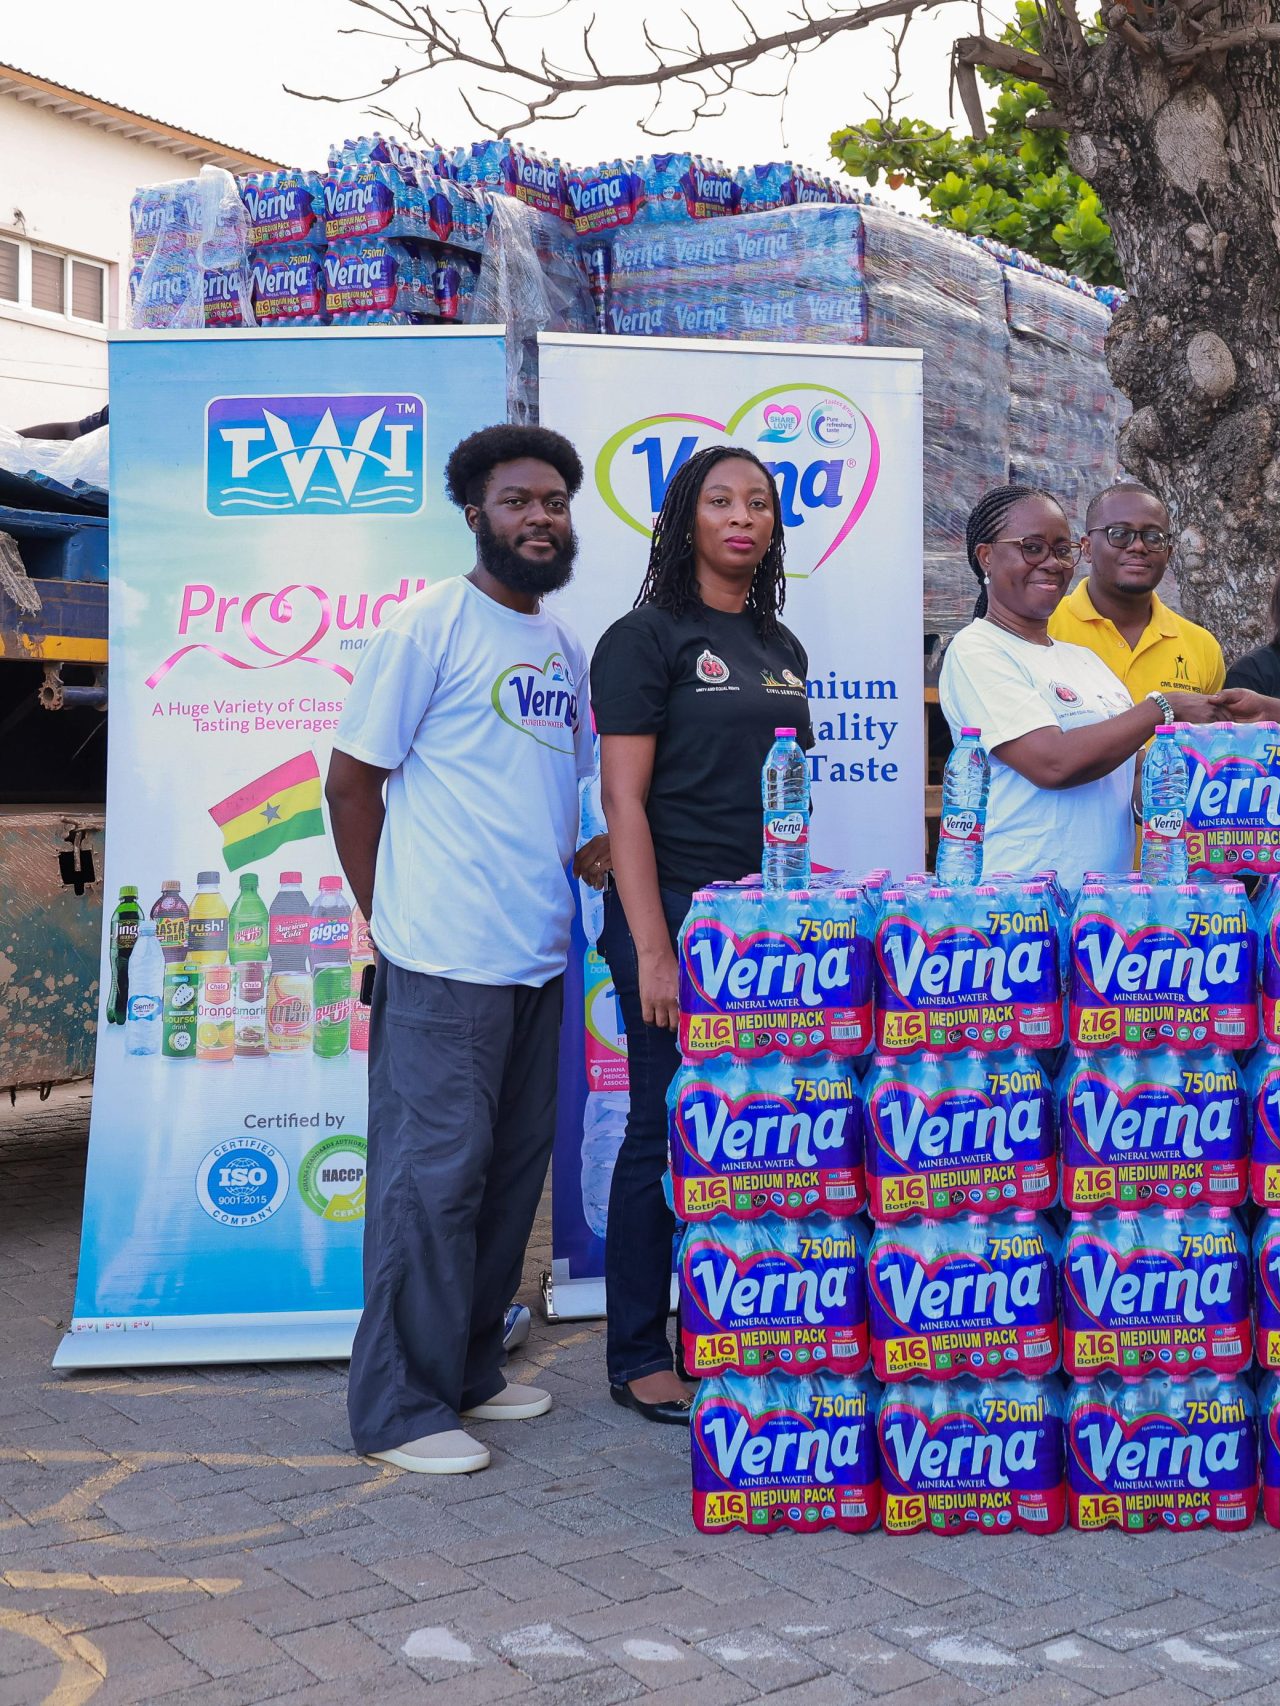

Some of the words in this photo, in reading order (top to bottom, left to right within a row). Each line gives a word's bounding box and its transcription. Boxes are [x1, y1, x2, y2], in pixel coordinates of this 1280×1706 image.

[514, 155, 557, 193] Verna
[694, 171, 732, 204] Verna
[245, 190, 296, 220] Verna
[324, 186, 373, 214] Verna
[569, 178, 621, 210] Verna
[251, 267, 308, 297] Verna
[325, 258, 382, 288] Verna
[609, 307, 662, 334] Verna
[219, 406, 414, 506] TWI
[396, 403, 416, 414] TM
[632, 436, 844, 528] Vna
[1173, 682, 1191, 691] SERVICE
[152, 703, 165, 716] A
[168, 701, 210, 717] Huge
[213, 699, 274, 715] Variety
[277, 698, 294, 712] of
[193, 718, 250, 734] Tasting
[254, 716, 340, 731] Beverages
[818, 712, 898, 750] ality
[805, 755, 898, 782] Taste
[772, 821, 801, 834] Verna
[945, 817, 973, 832] Verna
[1153, 817, 1182, 836] Verna
[1198, 819, 1235, 827] MINERAL
[1237, 817, 1265, 826] WATER
[1208, 831, 1254, 846] MEDIUM
[191, 920, 224, 932] rush!
[310, 923, 349, 942] Bigoo
[800, 918, 857, 941] 750ml
[691, 939, 850, 1006] Verna
[884, 936, 1044, 1001] Verna
[1078, 934, 1241, 1001] Verna
[726, 1000, 766, 1009] MINERAL
[769, 999, 799, 1007] WATER
[692, 1017, 729, 1038] x16
[737, 1012, 788, 1029] MEDIUM
[791, 1011, 824, 1028] PACK
[691, 1039, 731, 1048] Bottles
[244, 1113, 320, 1128] Certified
[325, 1113, 345, 1129] by
[684, 1102, 846, 1167] Verna
[879, 1098, 1043, 1166] Verna
[1073, 1091, 1232, 1159] Verna
[214, 1139, 275, 1157] CERTIFIED
[219, 1168, 268, 1187] ISO
[322, 1168, 364, 1182] HACCP
[218, 1196, 267, 1205] 9001:2015
[212, 1207, 274, 1225] COMPANY
[693, 1259, 849, 1324] Verna
[880, 1257, 1043, 1324] Verna
[1072, 1256, 1233, 1322] Verna
[705, 1416, 861, 1482] Verna
[886, 1419, 1038, 1486] Verna
[1079, 1419, 1240, 1487] Verna
